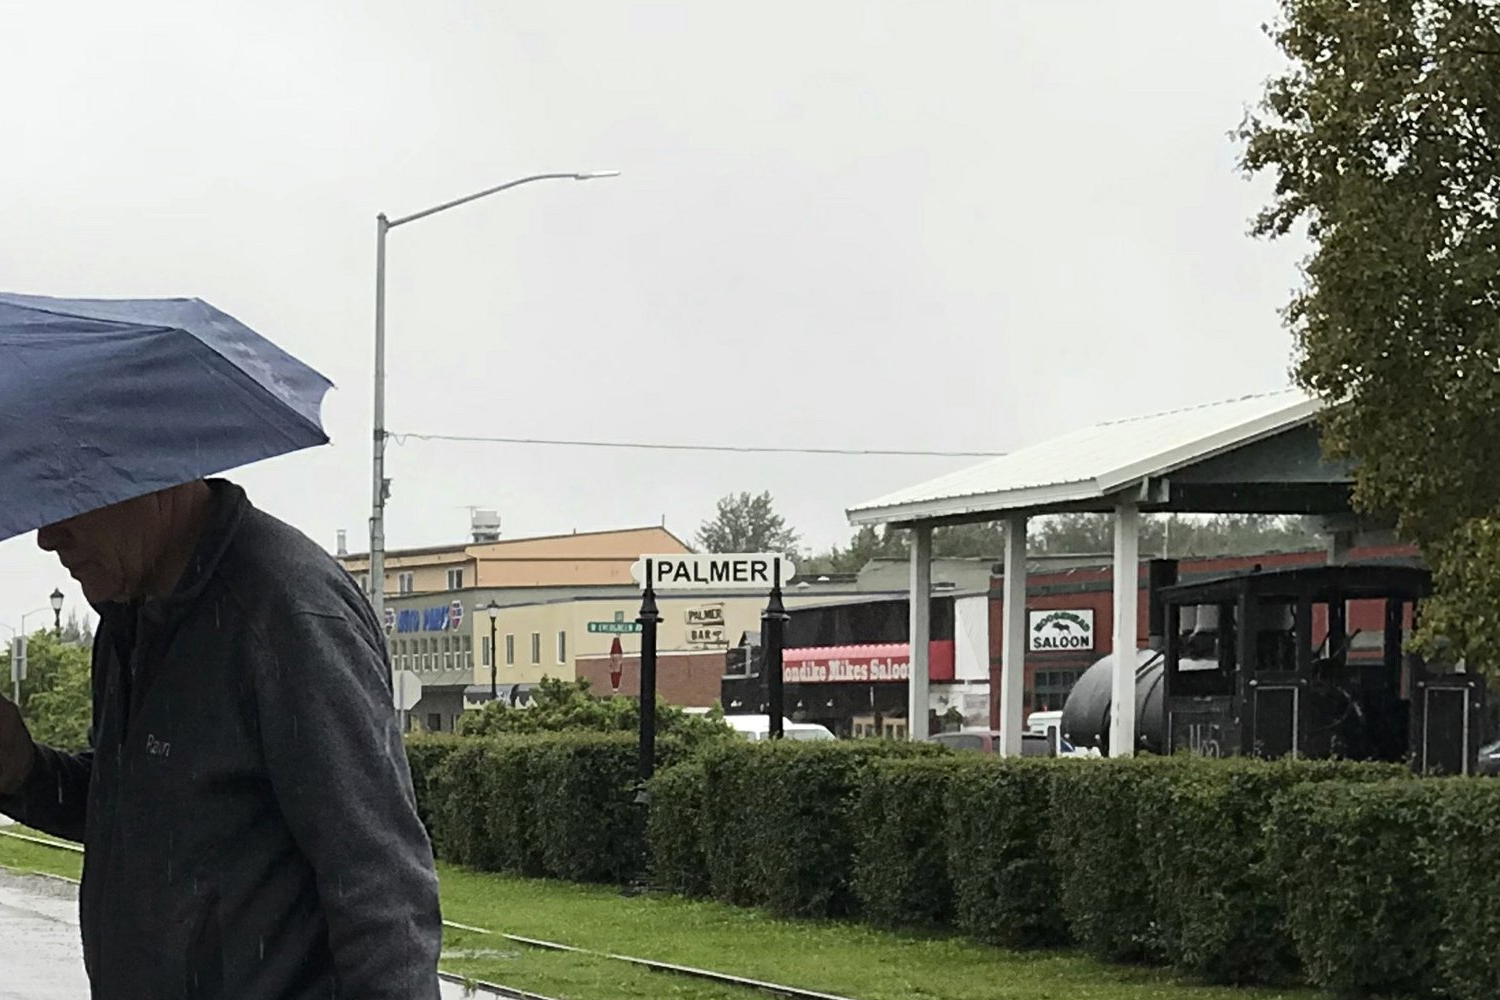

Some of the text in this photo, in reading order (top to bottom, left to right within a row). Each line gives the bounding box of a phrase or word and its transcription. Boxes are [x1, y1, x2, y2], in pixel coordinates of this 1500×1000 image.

[657, 560, 768, 584] PALMER
[691, 629, 711, 641] BAR
[1033, 636, 1090, 649] SALOON
[828, 659, 869, 681] Mikes
